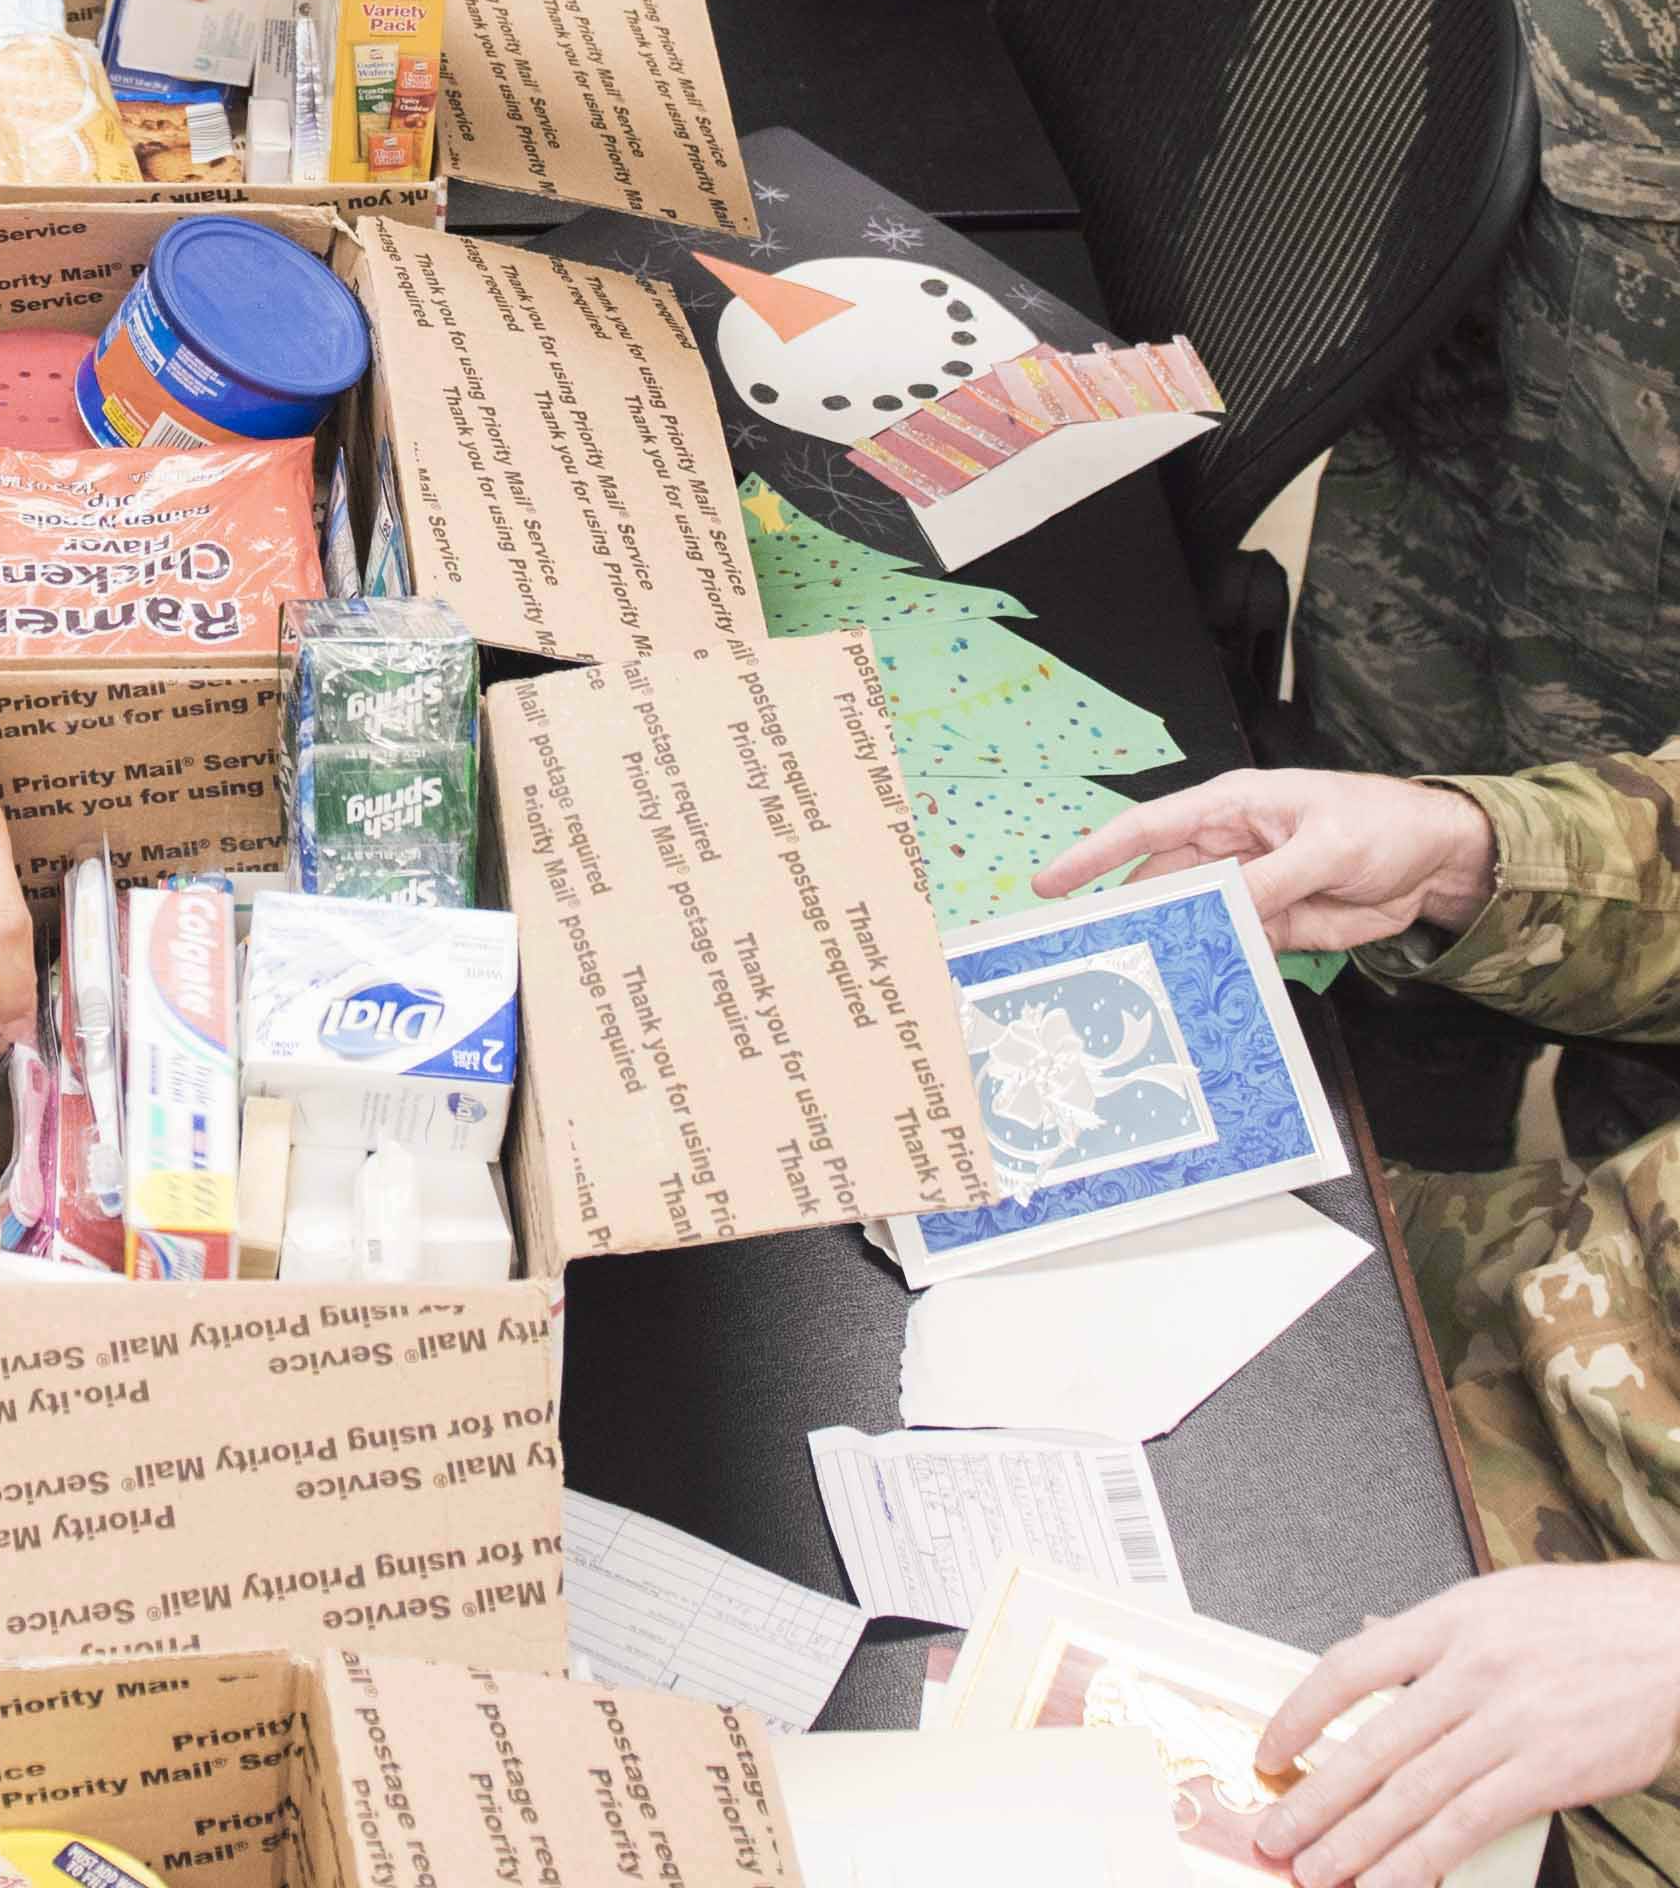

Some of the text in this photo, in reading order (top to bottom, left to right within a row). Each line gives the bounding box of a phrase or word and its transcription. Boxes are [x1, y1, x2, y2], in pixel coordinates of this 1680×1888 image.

[363, 3, 427, 20] Variety
[370, 19, 417, 33] Pack
[63, 534, 170, 557] Flavor
[0, 541, 233, 595] Chicken
[346, 777, 443, 825] Spring
[363, 805, 424, 840] Irish
[321, 997, 446, 1046] Dial
[481, 1038, 505, 1073] 2
[267, 1326, 489, 1376] Mail® Service
[51, 1504, 177, 1543] Priority
